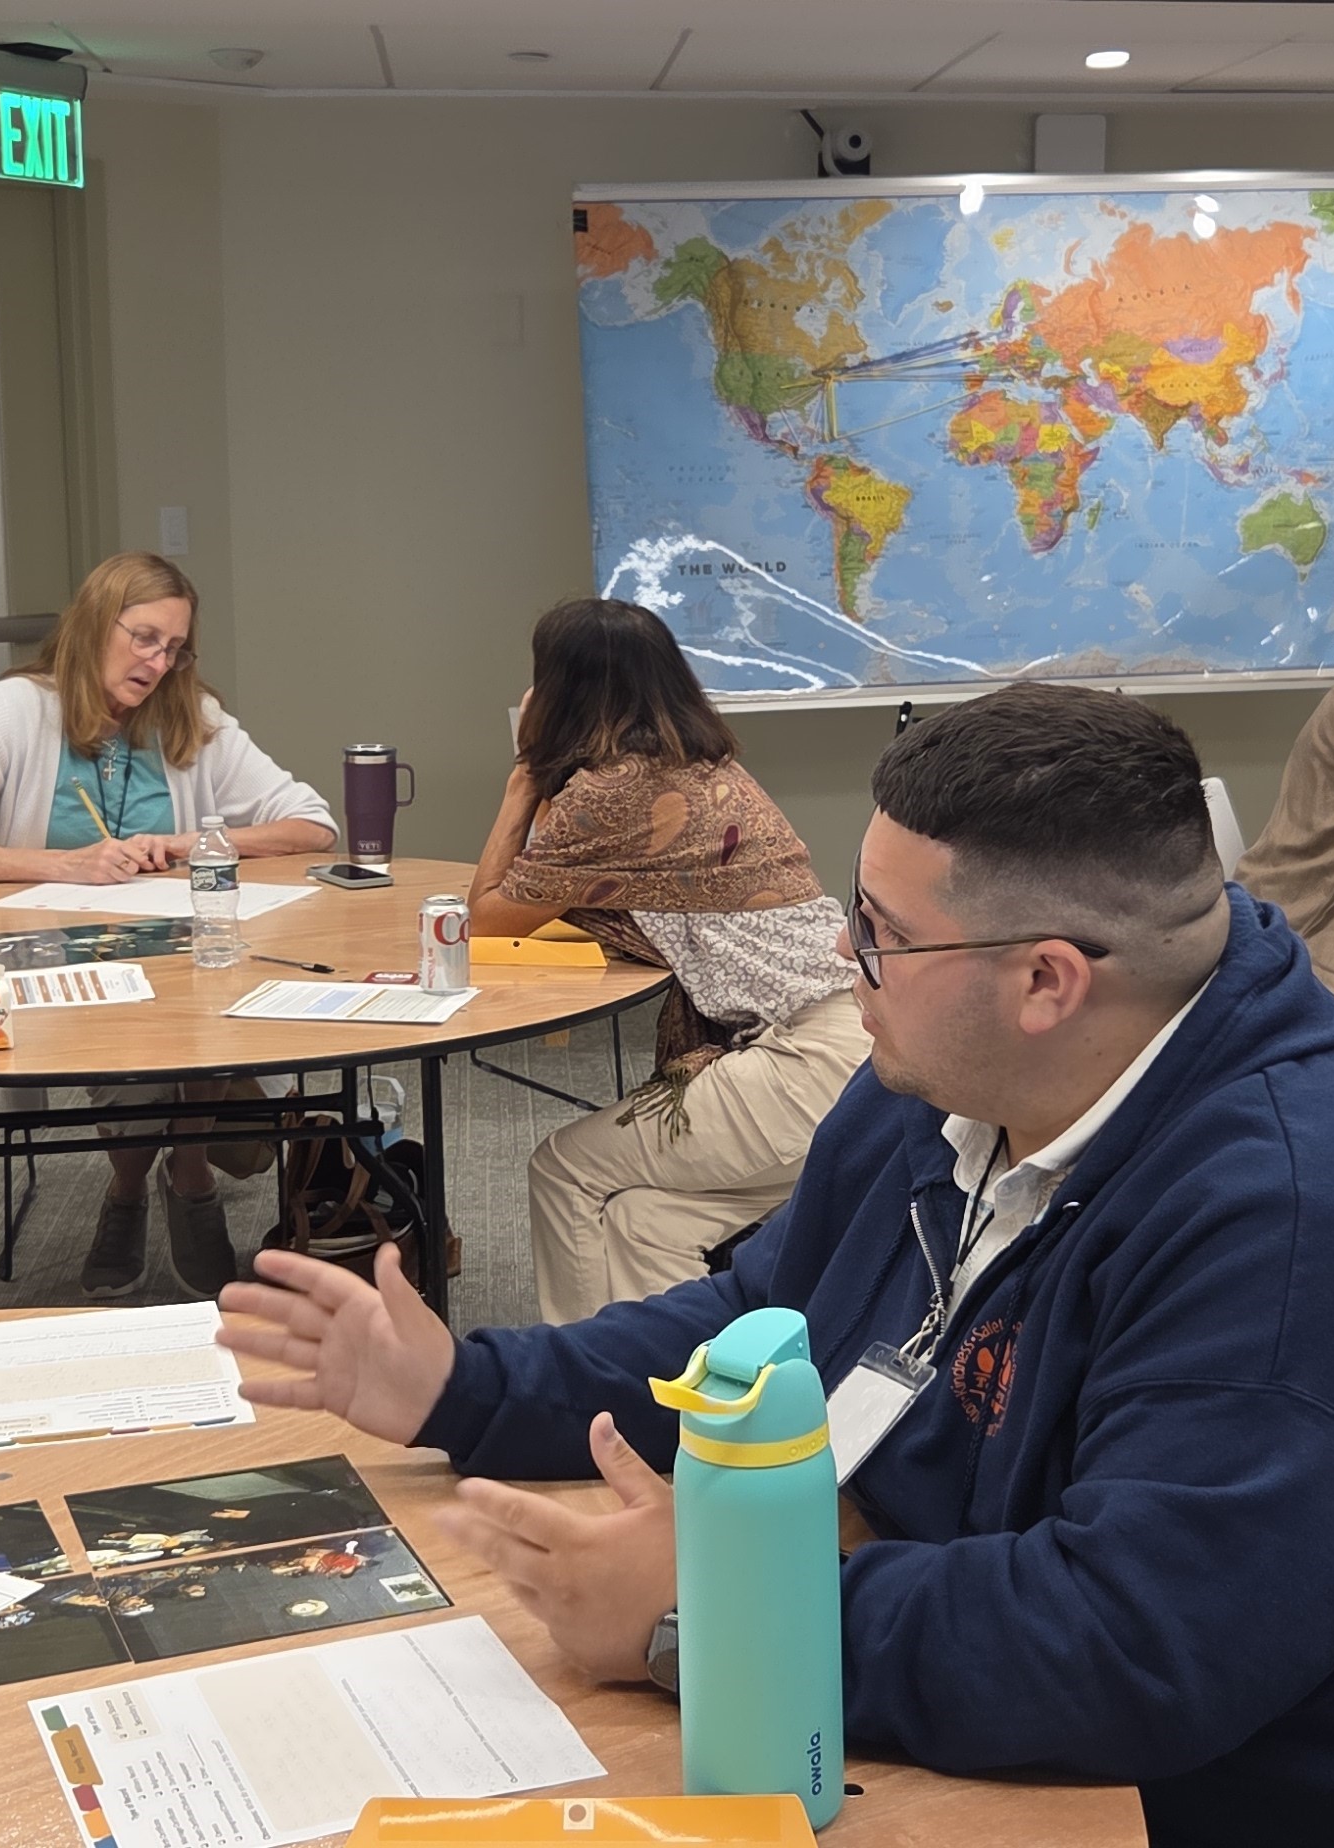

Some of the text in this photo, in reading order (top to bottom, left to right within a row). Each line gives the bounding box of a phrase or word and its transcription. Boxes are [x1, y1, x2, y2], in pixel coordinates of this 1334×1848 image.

[677, 561, 787, 576] THE WORLD
[358, 842, 380, 850] YETI
[806, 1731, 822, 1796] owala
